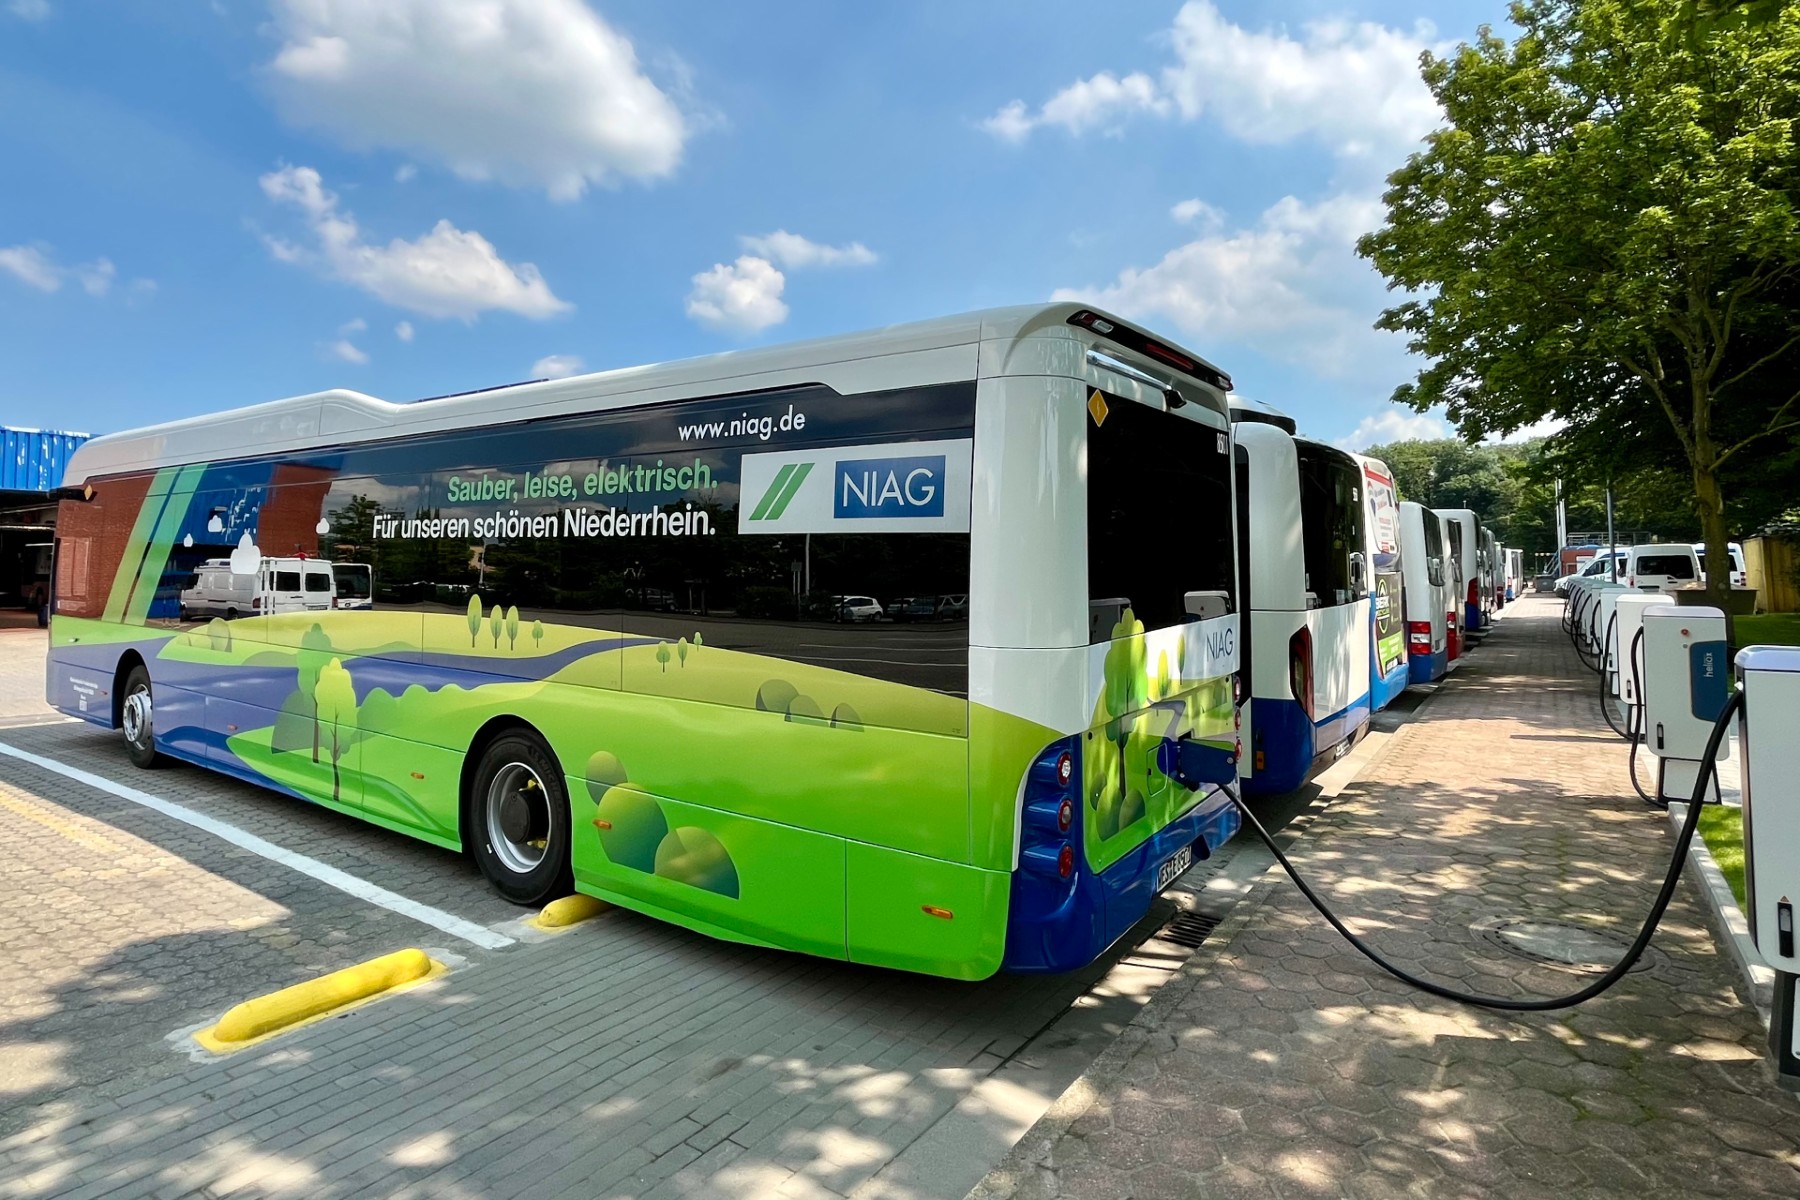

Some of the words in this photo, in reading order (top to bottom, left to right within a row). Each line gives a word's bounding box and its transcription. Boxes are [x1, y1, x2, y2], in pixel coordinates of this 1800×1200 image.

[678, 405, 806, 442] www.niag.de
[447, 474, 518, 503] Sauber,
[523, 469, 578, 501] leise,
[583, 458, 718, 496] elektrisch.
[843, 468, 935, 507] NIAG
[372, 514, 399, 539] Für
[401, 517, 469, 539] unseren
[472, 510, 559, 538] schönen
[563, 503, 716, 538] Niederrhein.
[1206, 627, 1233, 662] NIAG
[1703, 652, 1714, 678] heliox
